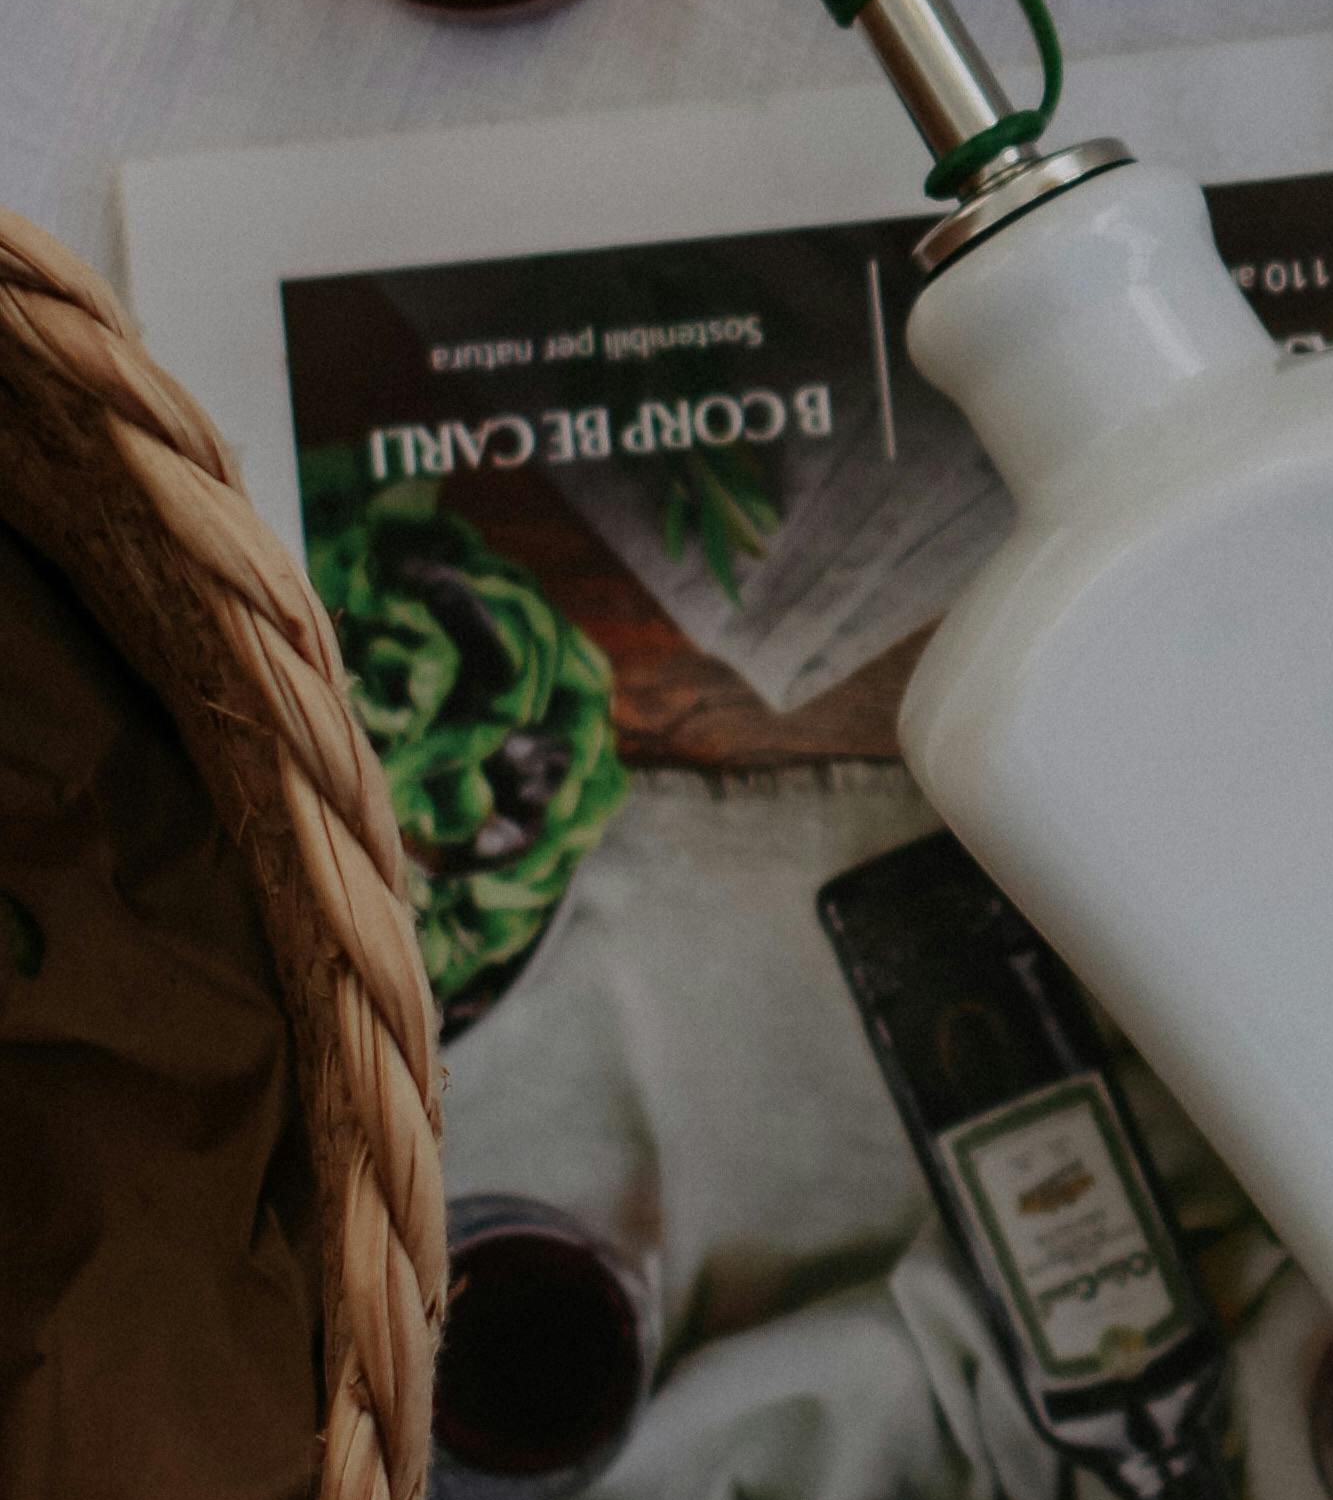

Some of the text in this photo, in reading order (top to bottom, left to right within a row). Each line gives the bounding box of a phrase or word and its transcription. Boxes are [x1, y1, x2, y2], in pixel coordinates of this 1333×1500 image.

[1263, 257, 1331, 292] 110
[429, 314, 764, 373] Sostenibili per natura
[368, 384, 832, 480] B CORP BE CARLI
